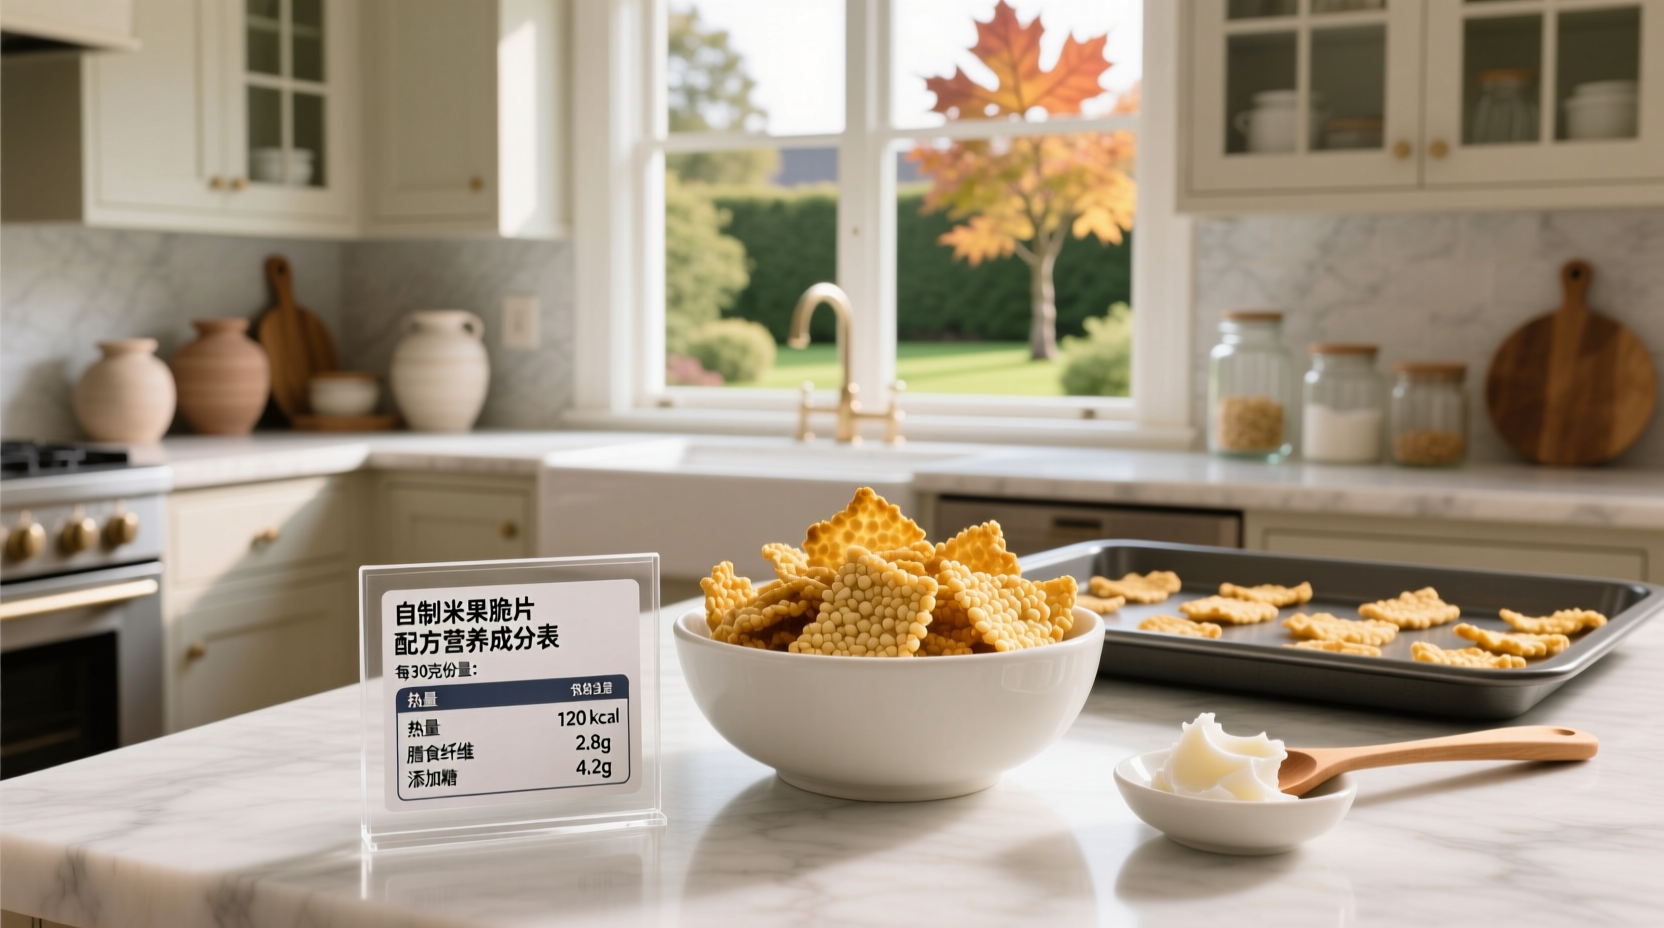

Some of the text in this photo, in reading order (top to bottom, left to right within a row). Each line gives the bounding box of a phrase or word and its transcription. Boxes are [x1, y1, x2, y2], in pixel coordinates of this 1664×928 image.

[396, 596, 535, 626] 自制米果脆片
[394, 623, 559, 656] 配方营养成分表
[558, 707, 619, 727] 120 kcal
[575, 734, 611, 754] 2.8g
[575, 758, 612, 779] 4.2g
